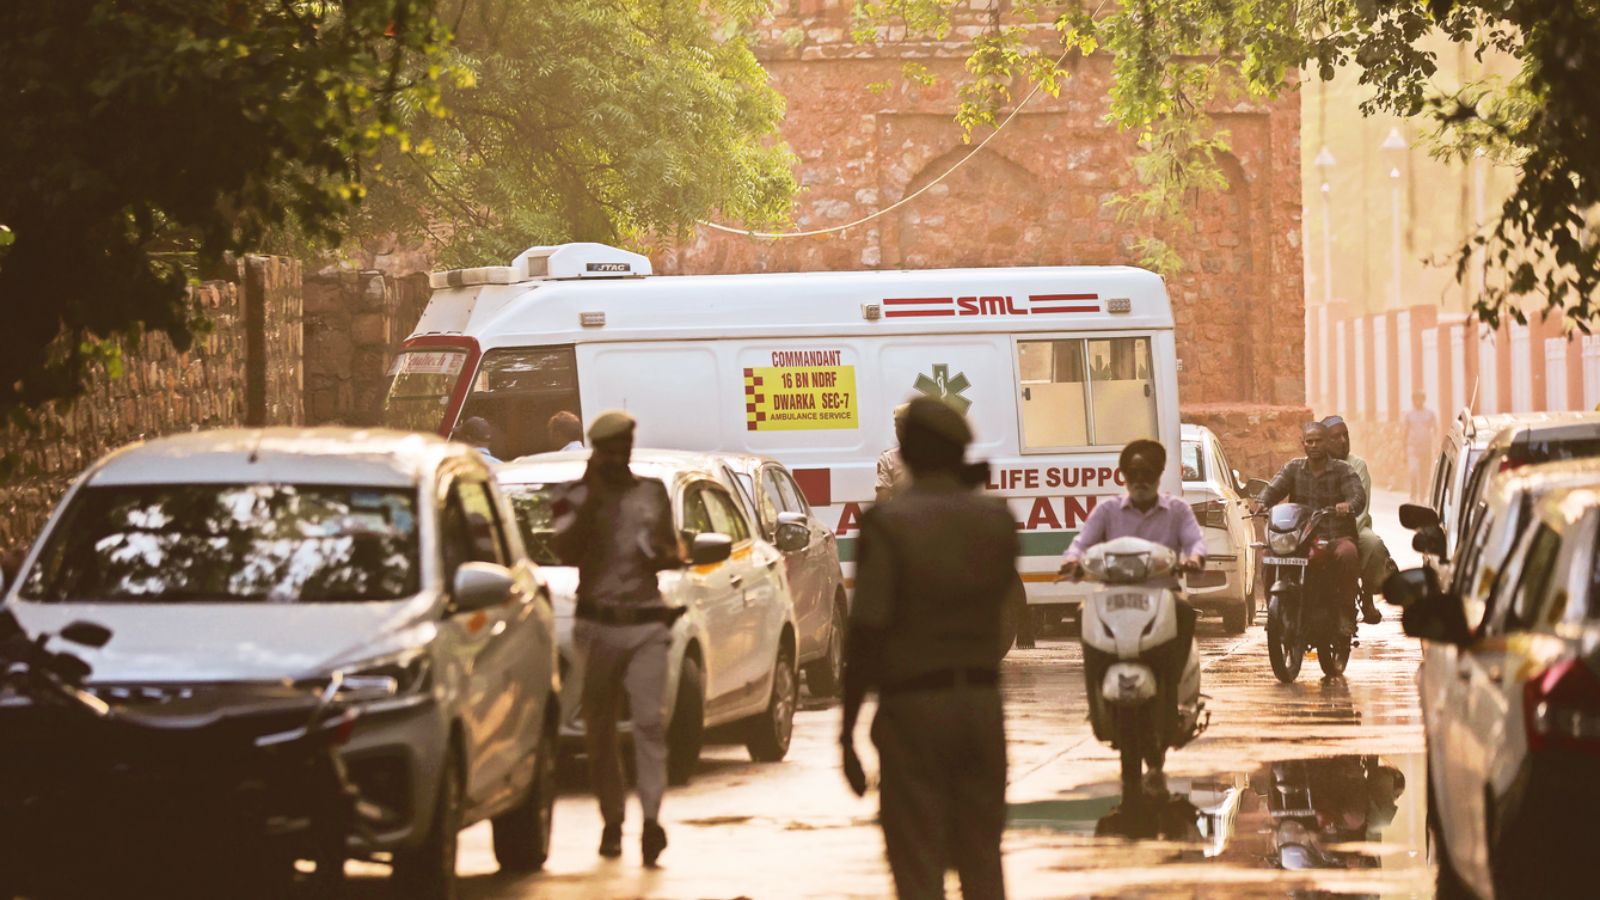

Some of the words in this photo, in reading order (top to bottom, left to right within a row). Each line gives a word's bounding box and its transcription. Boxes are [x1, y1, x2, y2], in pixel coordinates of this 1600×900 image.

[956, 296, 1028, 315] SML
[771, 350, 841, 367] COMMANDANT
[781, 372, 793, 389] 16
[795, 372, 809, 388] BN
[811, 371, 837, 388] NDRF
[773, 393, 816, 410] DWARKA
[821, 392, 849, 409] SEC-7
[770, 412, 817, 421] AMBULANCE
[819, 411, 851, 420] SERVICE
[985, 469, 1039, 490] LIFE
[1046, 467, 1127, 488] SUPPO
